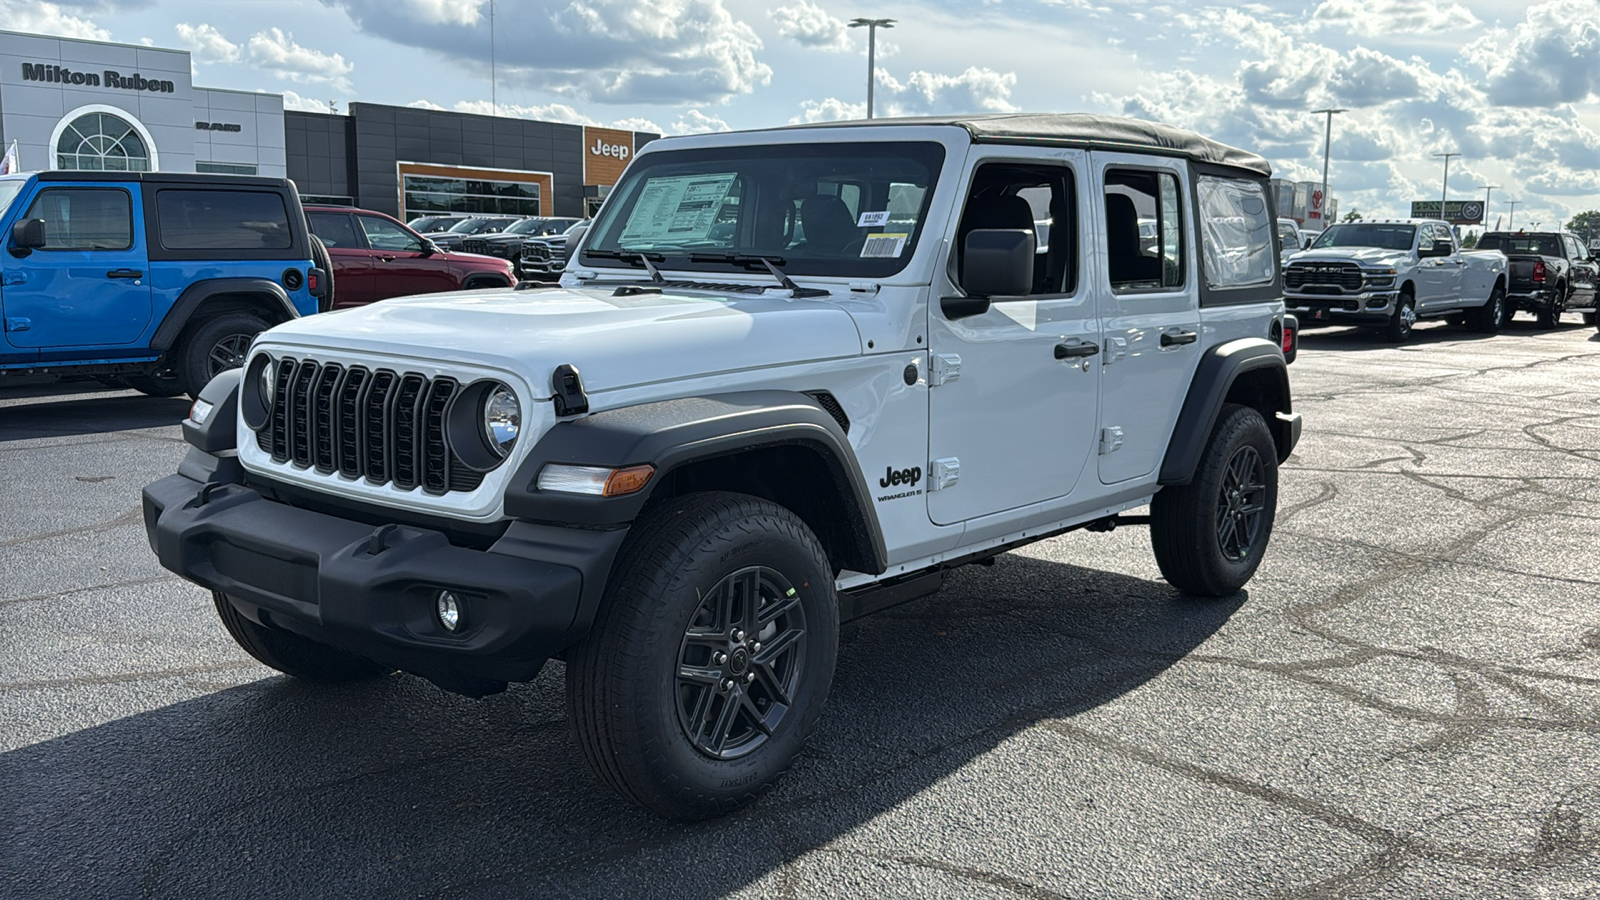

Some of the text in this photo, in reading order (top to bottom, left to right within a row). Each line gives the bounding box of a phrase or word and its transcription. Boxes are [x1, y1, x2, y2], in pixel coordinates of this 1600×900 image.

[22, 62, 174, 93] Milton Ruben
[195, 121, 242, 133] RAM
[591, 138, 629, 161] Jeep
[879, 465, 922, 488] Jeep
[877, 490, 916, 503] WRANGLER
